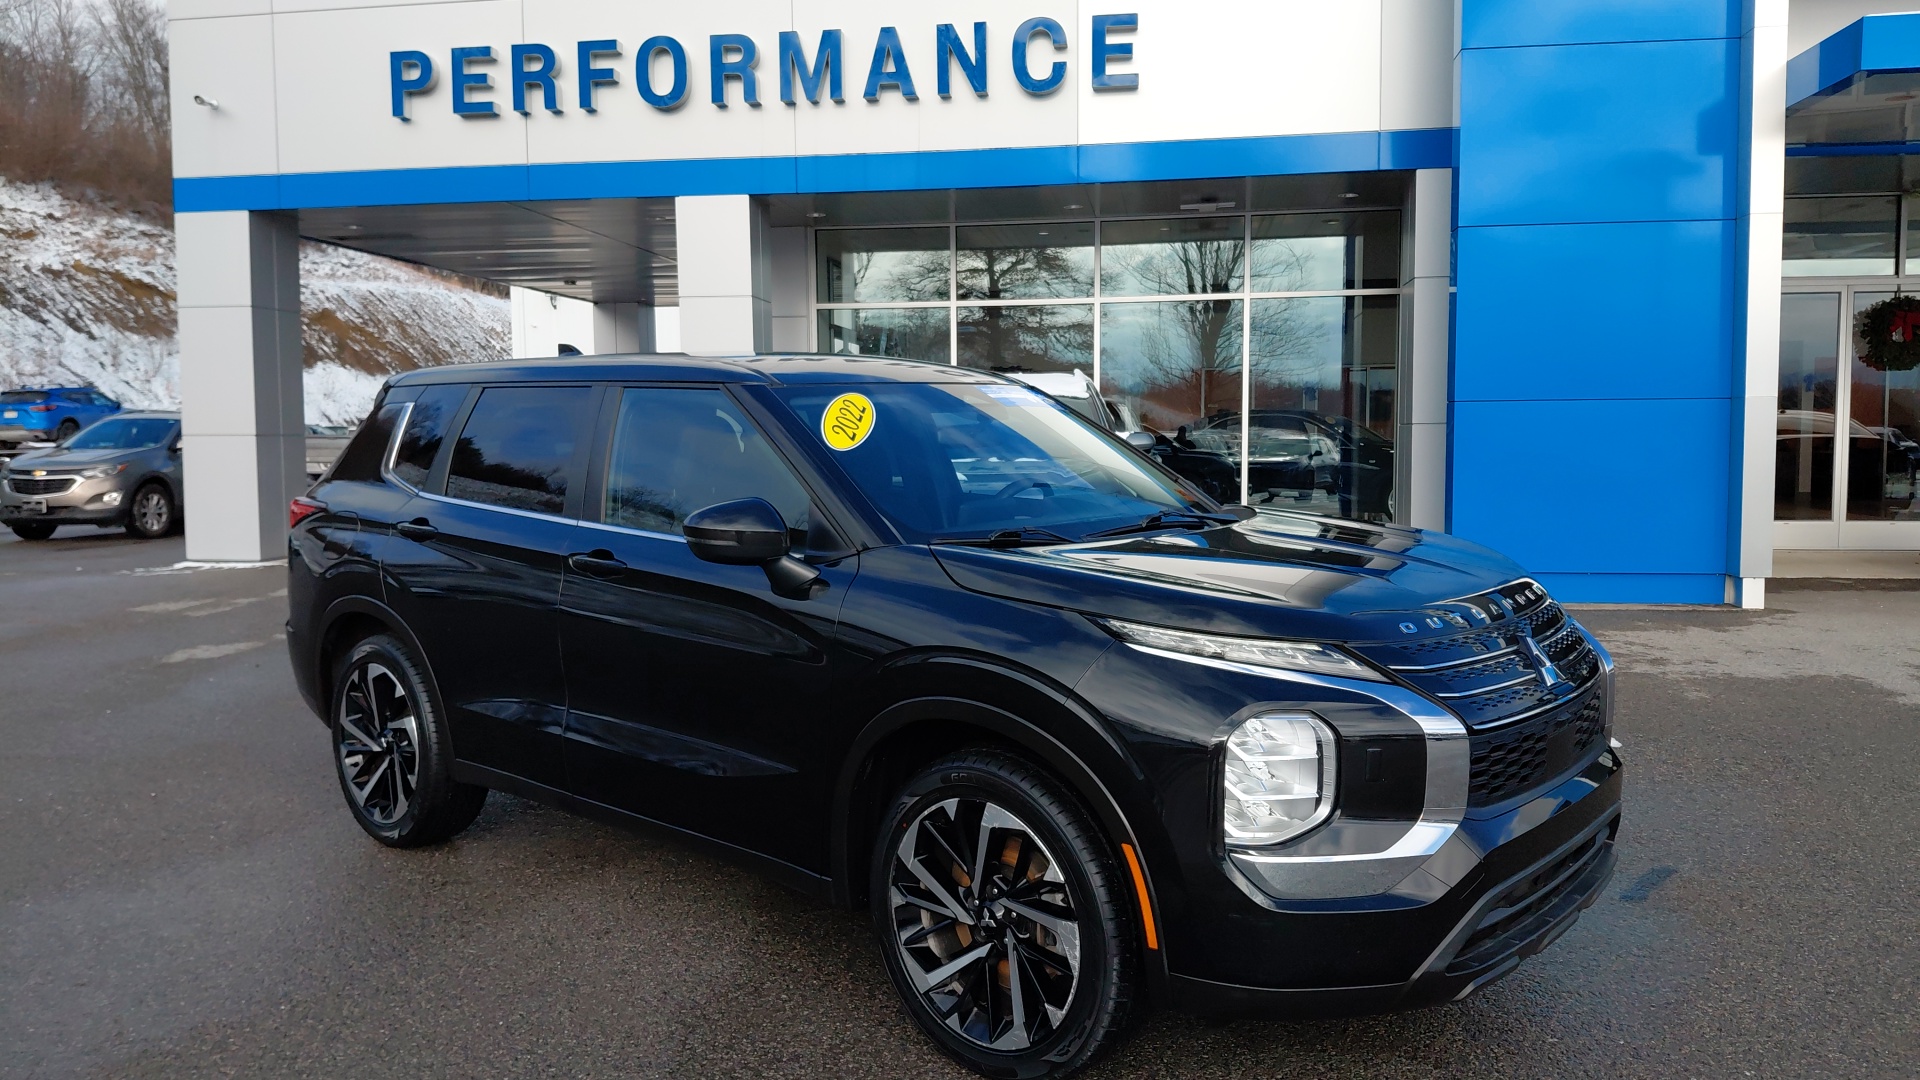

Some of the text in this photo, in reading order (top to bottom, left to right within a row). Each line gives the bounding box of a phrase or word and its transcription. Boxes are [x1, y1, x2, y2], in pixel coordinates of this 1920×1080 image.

[390, 13, 1139, 121] PERFORMANCE
[832, 399, 867, 442] 2022
[1399, 583, 1544, 635] OUTLANDER
